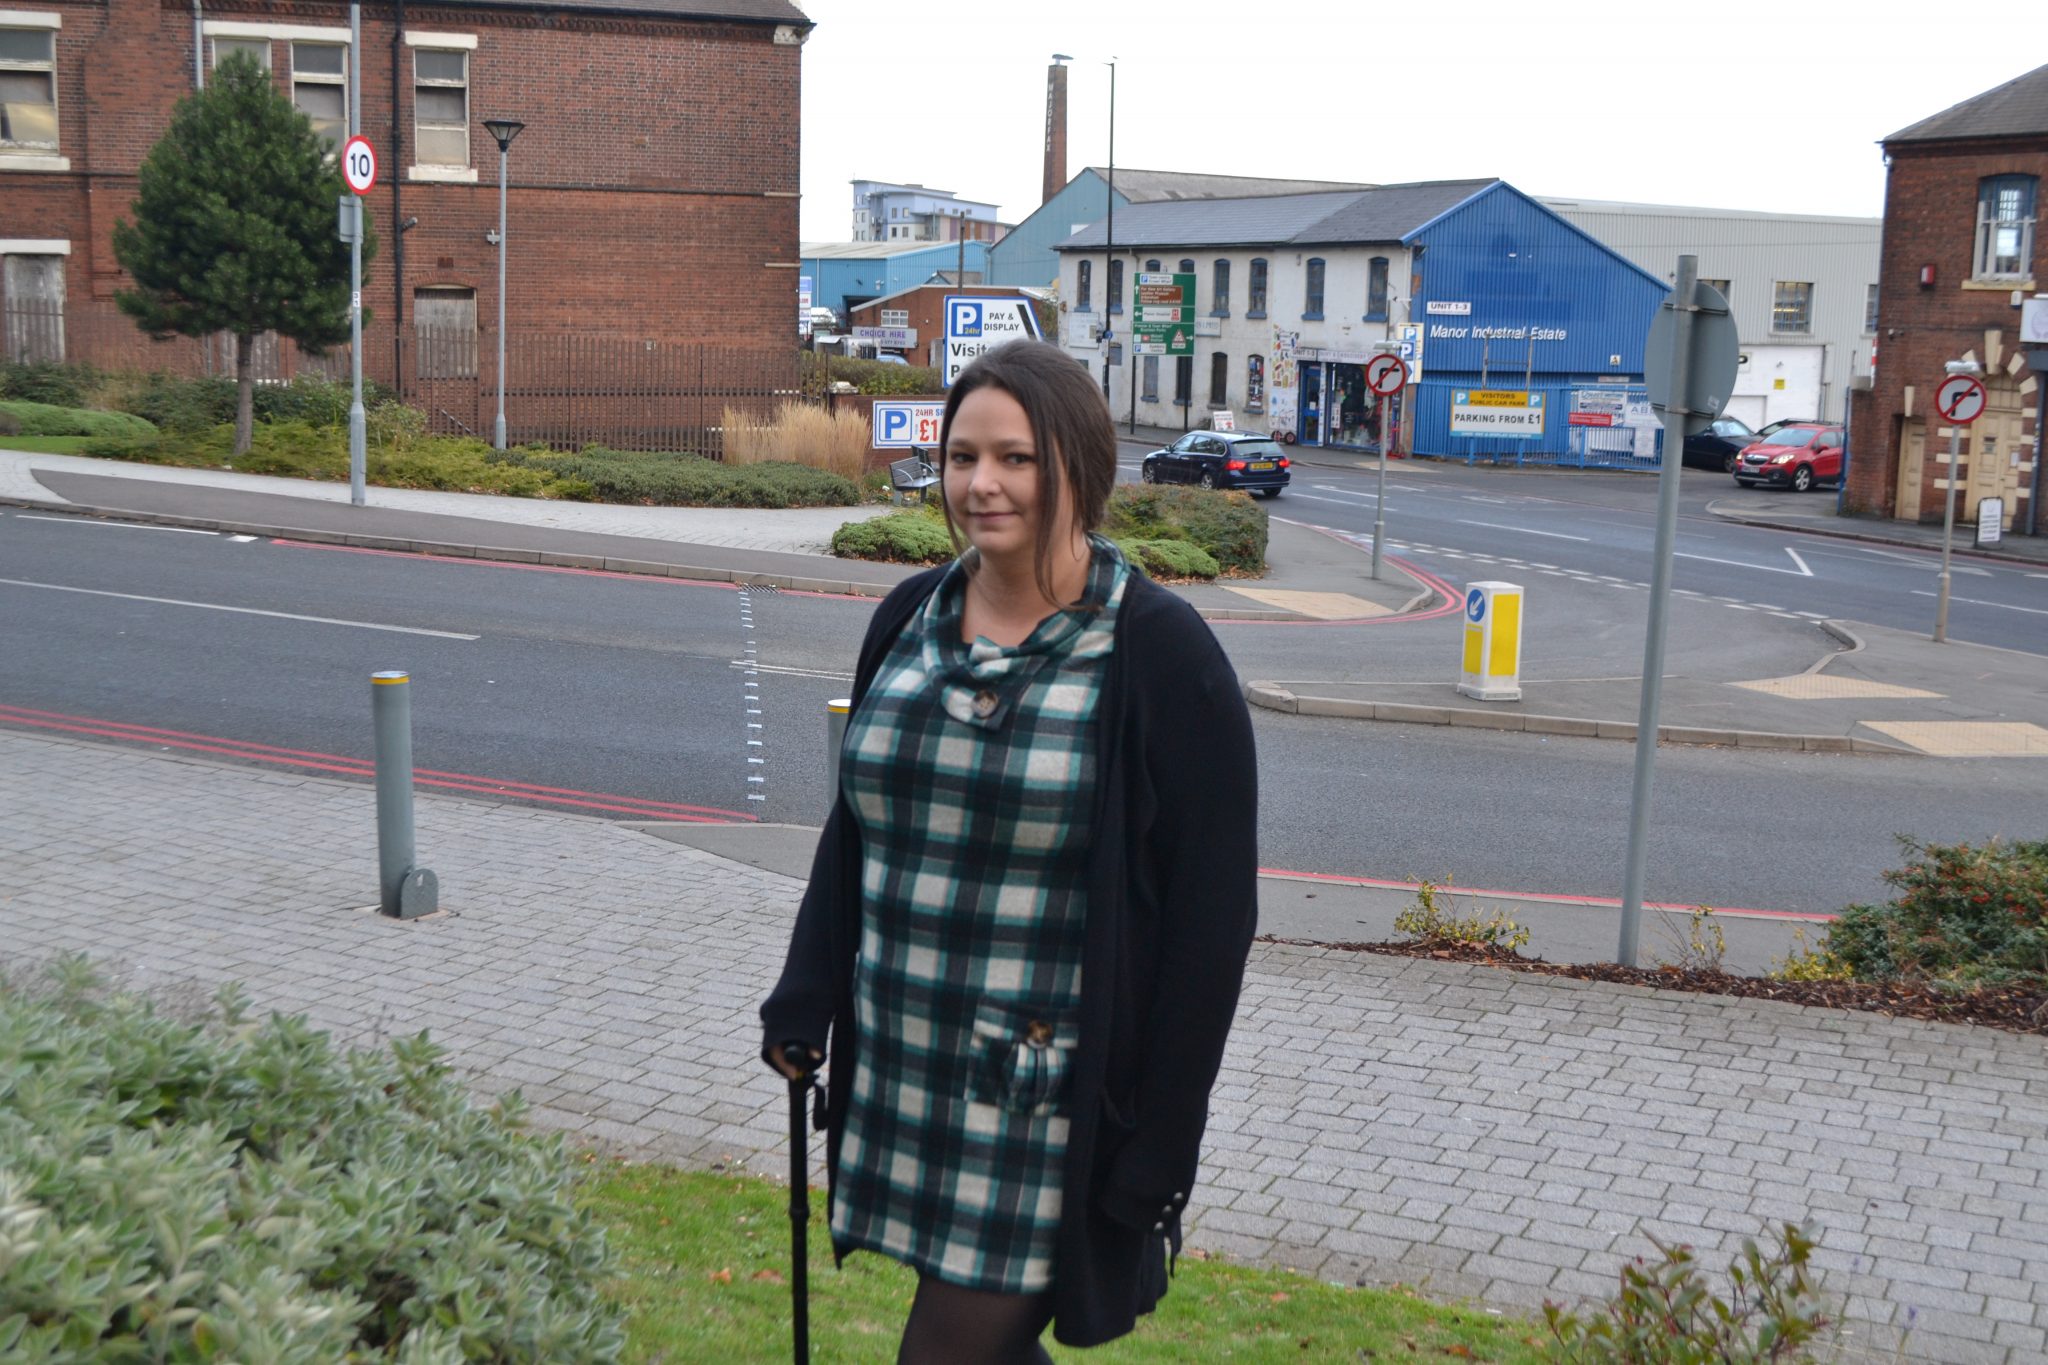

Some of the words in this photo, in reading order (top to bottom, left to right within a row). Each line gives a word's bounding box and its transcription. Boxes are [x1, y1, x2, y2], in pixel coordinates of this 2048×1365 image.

[351, 153, 370, 177] 10
[956, 305, 977, 335] P
[989, 312, 1005, 320] PAY
[964, 327, 981, 335] 24hr
[984, 323, 1020, 331] DISPLAY
[1430, 325, 1468, 339] Manor
[1472, 326, 1527, 340] Industrial
[1530, 327, 1567, 341] Estate
[860, 329, 886, 337] CHOICE
[889, 331, 906, 339] HIRE
[1406, 328, 1416, 340] P
[1401, 342, 1412, 360] P
[1456, 392, 1466, 404] P
[1530, 394, 1540, 406] P
[915, 408, 934, 417] 24HR
[1454, 413, 1495, 423] PARKING
[1498, 415, 1524, 424] FROM
[1528, 414, 1541, 424] £1
[885, 410, 907, 439] P
